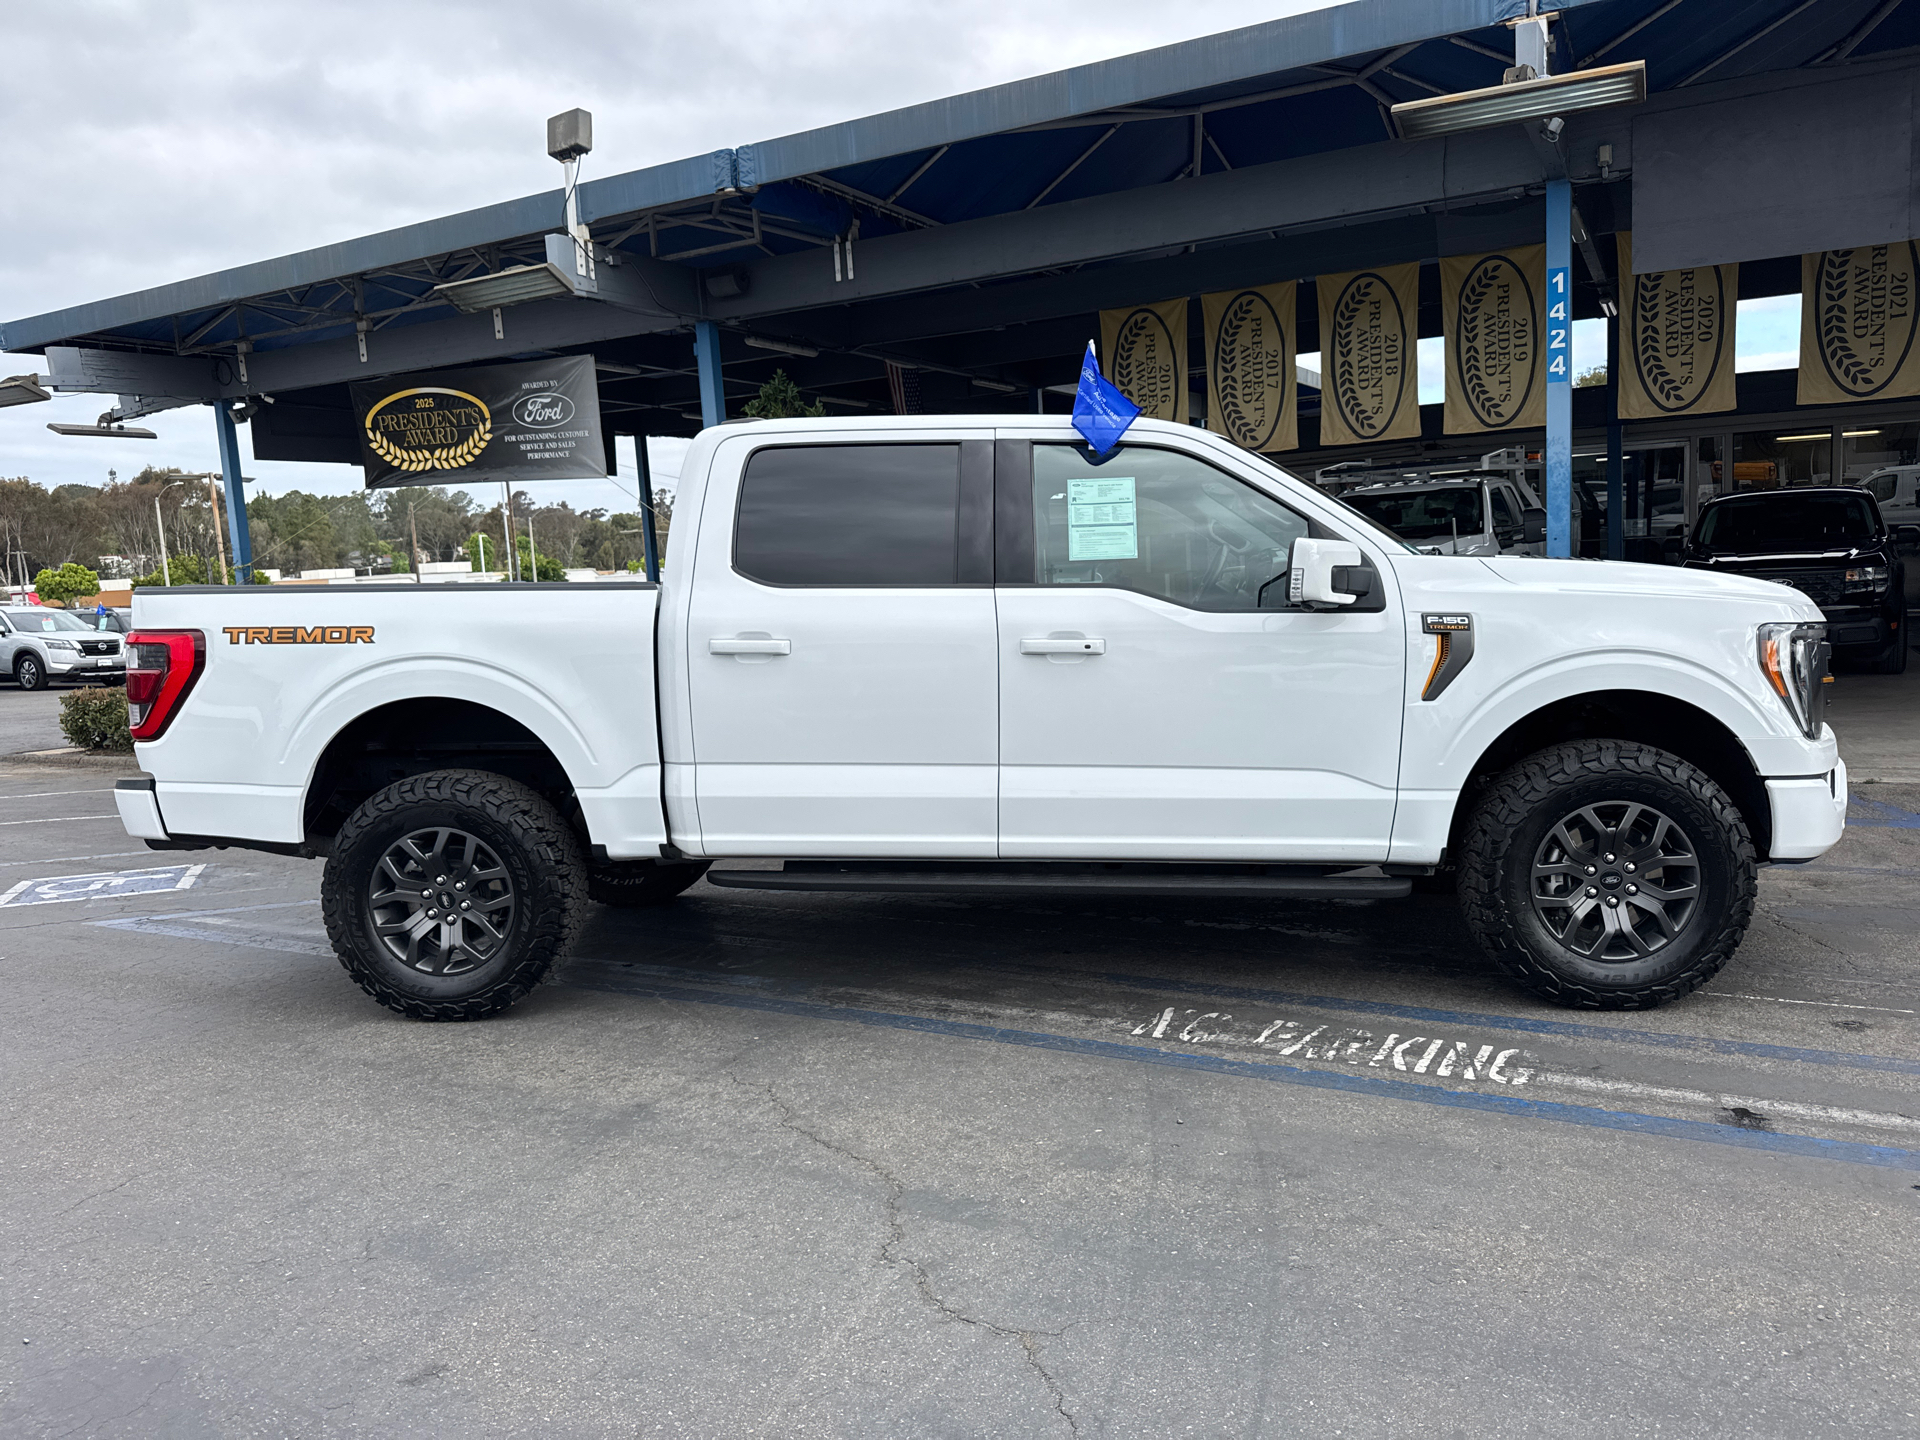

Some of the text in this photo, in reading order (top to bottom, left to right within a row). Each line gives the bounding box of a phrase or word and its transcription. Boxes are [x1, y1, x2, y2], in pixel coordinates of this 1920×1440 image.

[1697, 295, 1714, 342] 2020
[1854, 265, 1870, 339] AWARD
[1869, 244, 1888, 368] RESIDENT'S
[1889, 272, 1908, 320] 2021
[1484, 312, 1497, 377] AWARD
[1497, 282, 1511, 403] PRESIDENT'S
[1513, 318, 1528, 362] 2019
[1549, 272, 1566, 375] 1424
[1665, 289, 1679, 358] AWARD
[1680, 269, 1694, 385] RESIDENT'S
[1145, 333, 1158, 418] PRESIDEN
[1240, 344, 1252, 404] AWARD
[1251, 316, 1265, 428] PRESIDENT'S
[1265, 349, 1278, 389] 2017
[1356, 327, 1370, 390] AWARD
[1369, 299, 1383, 415] PRESIDENT'S
[1384, 333, 1398, 376] 2018
[415, 398, 434, 409] 2025
[521, 381, 549, 390] AWARDED
[1135, 359, 1148, 417] AWARD
[1159, 364, 1171, 404] 2016
[377, 407, 480, 432] PRESIDENT'S
[524, 398, 563, 422] Ford
[403, 427, 458, 447] AWARD
[517, 432, 557, 441] OUTSTANDING
[558, 430, 589, 438] CUSTOMER
[527, 451, 570, 459] PERFORMANCE
[222, 626, 375, 644] TREMOR
[1427, 616, 1468, 624] F-150
[594, 873, 645, 886] All-Ter
